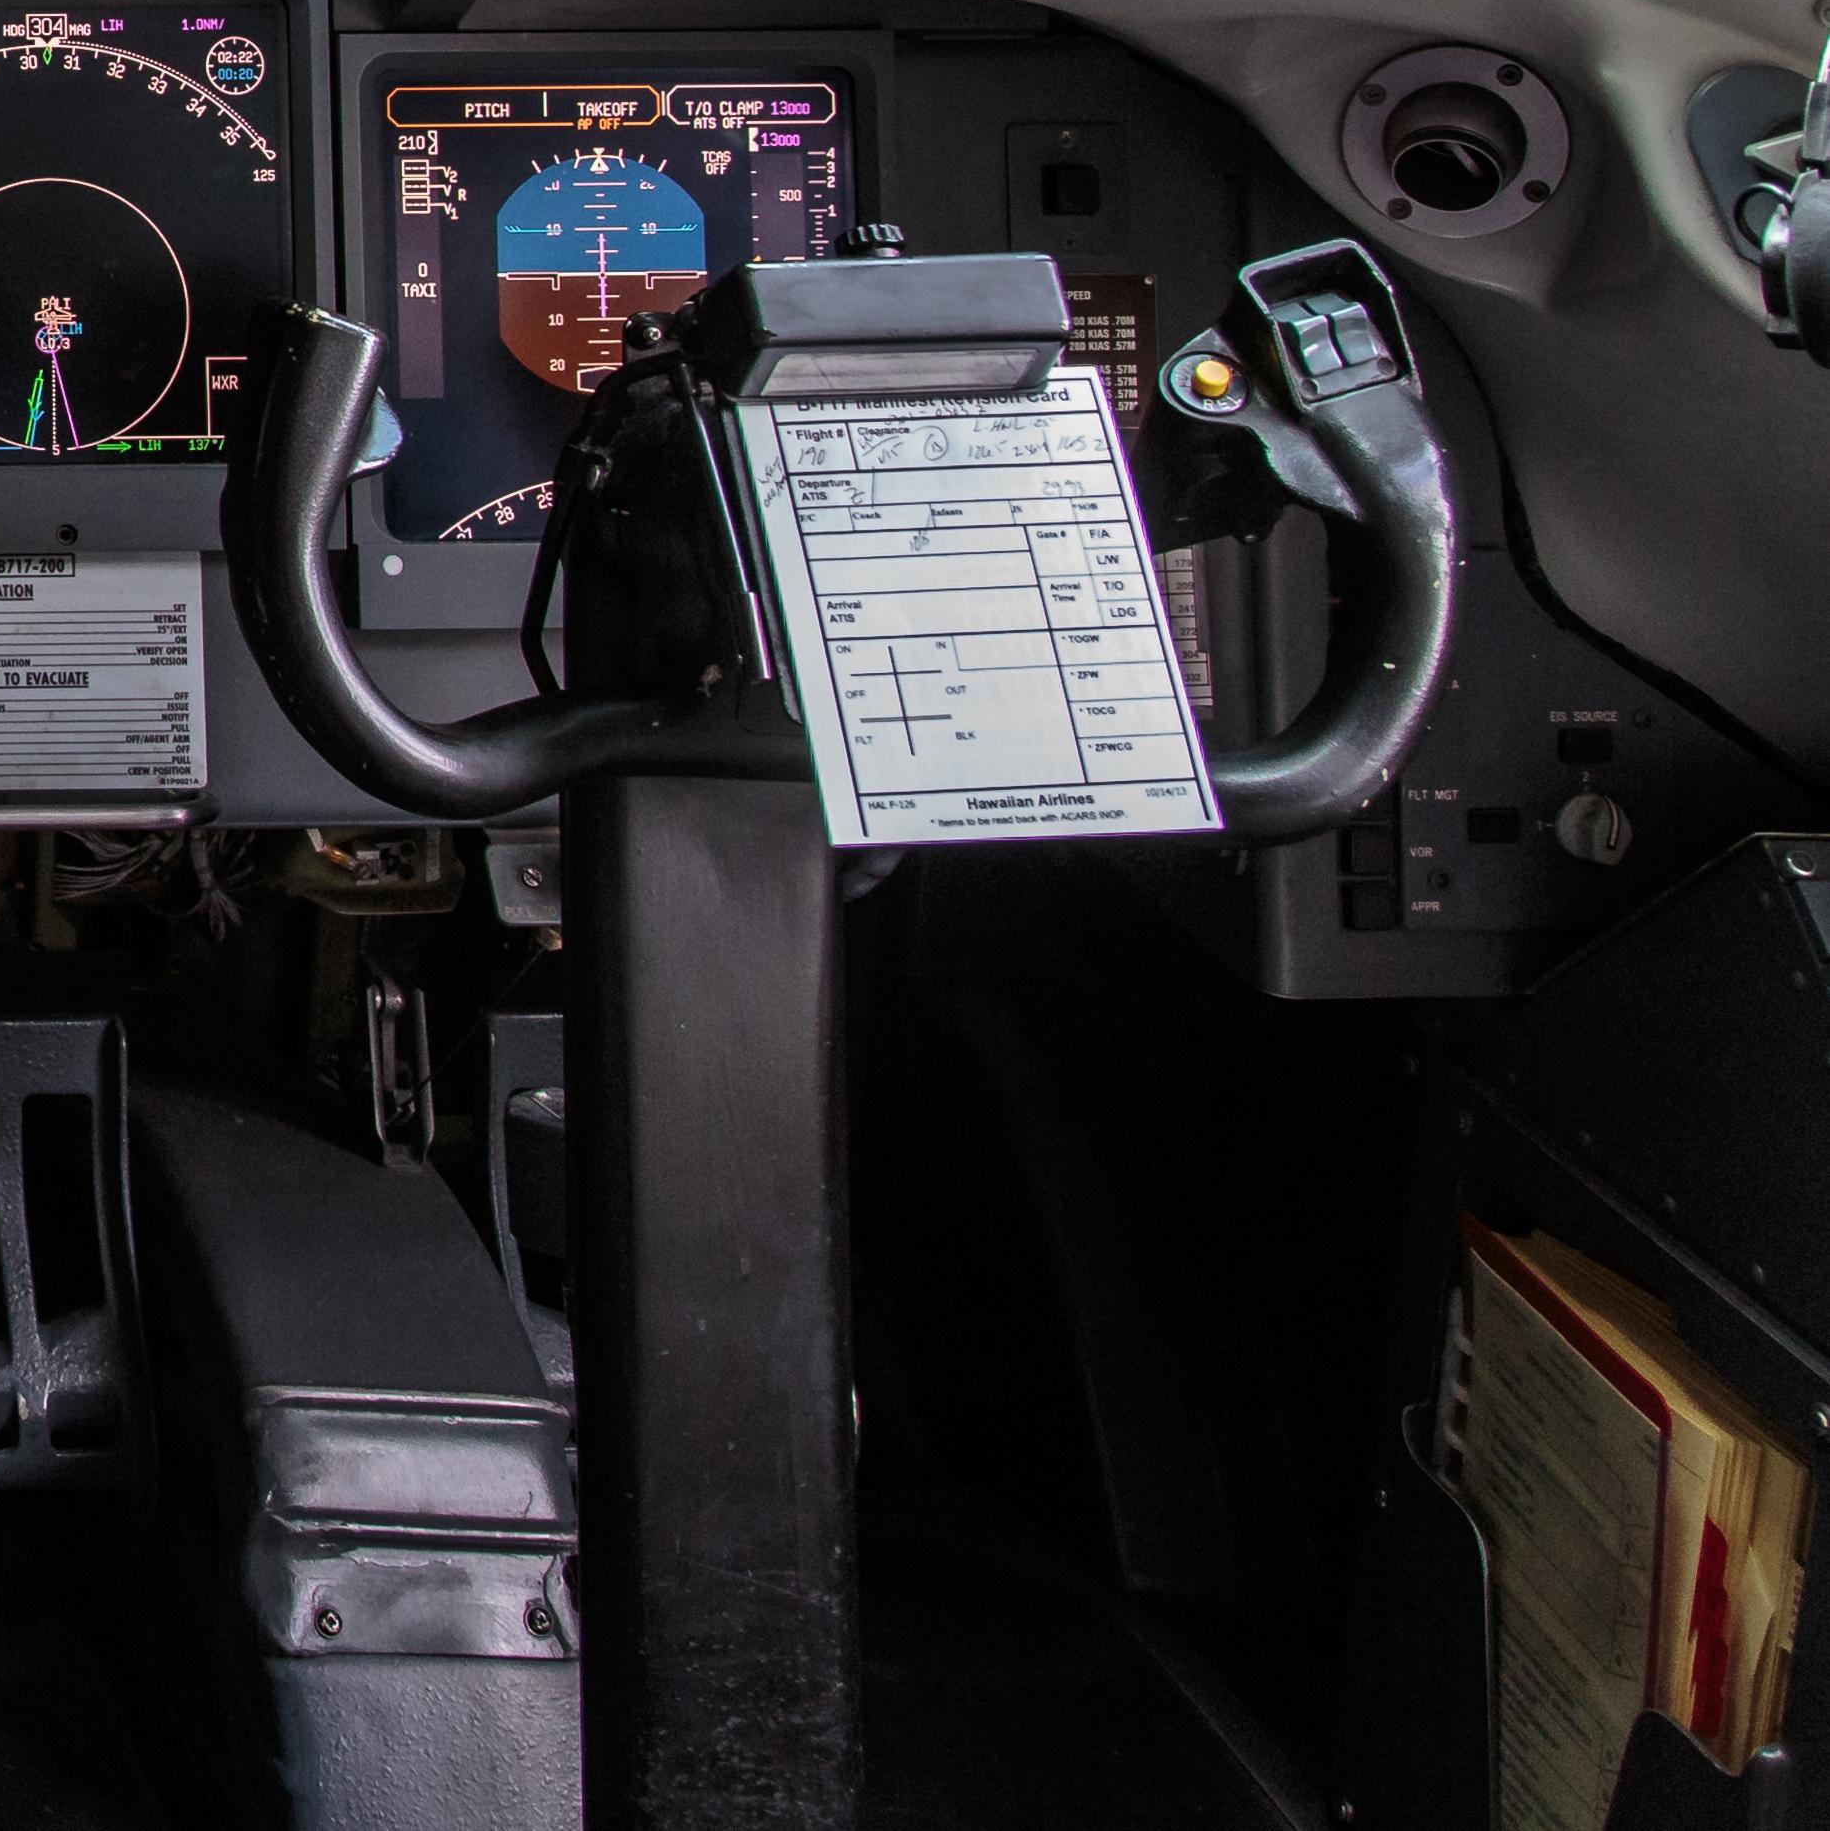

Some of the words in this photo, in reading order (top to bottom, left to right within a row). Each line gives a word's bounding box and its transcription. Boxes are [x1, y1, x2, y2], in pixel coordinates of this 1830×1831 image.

[464, 103, 510, 118] PITCH
[577, 102, 638, 117] TAKEOFF
[685, 101, 712, 115] T/O
[719, 100, 764, 115] CLAMP
[402, 282, 436, 297] TAXI
[798, 477, 851, 491] Departure
[5, 672, 20, 686] TO
[26, 671, 89, 686] EVACUATE
[966, 795, 1031, 810] Hawaiian
[1037, 791, 1095, 808] Airlines
